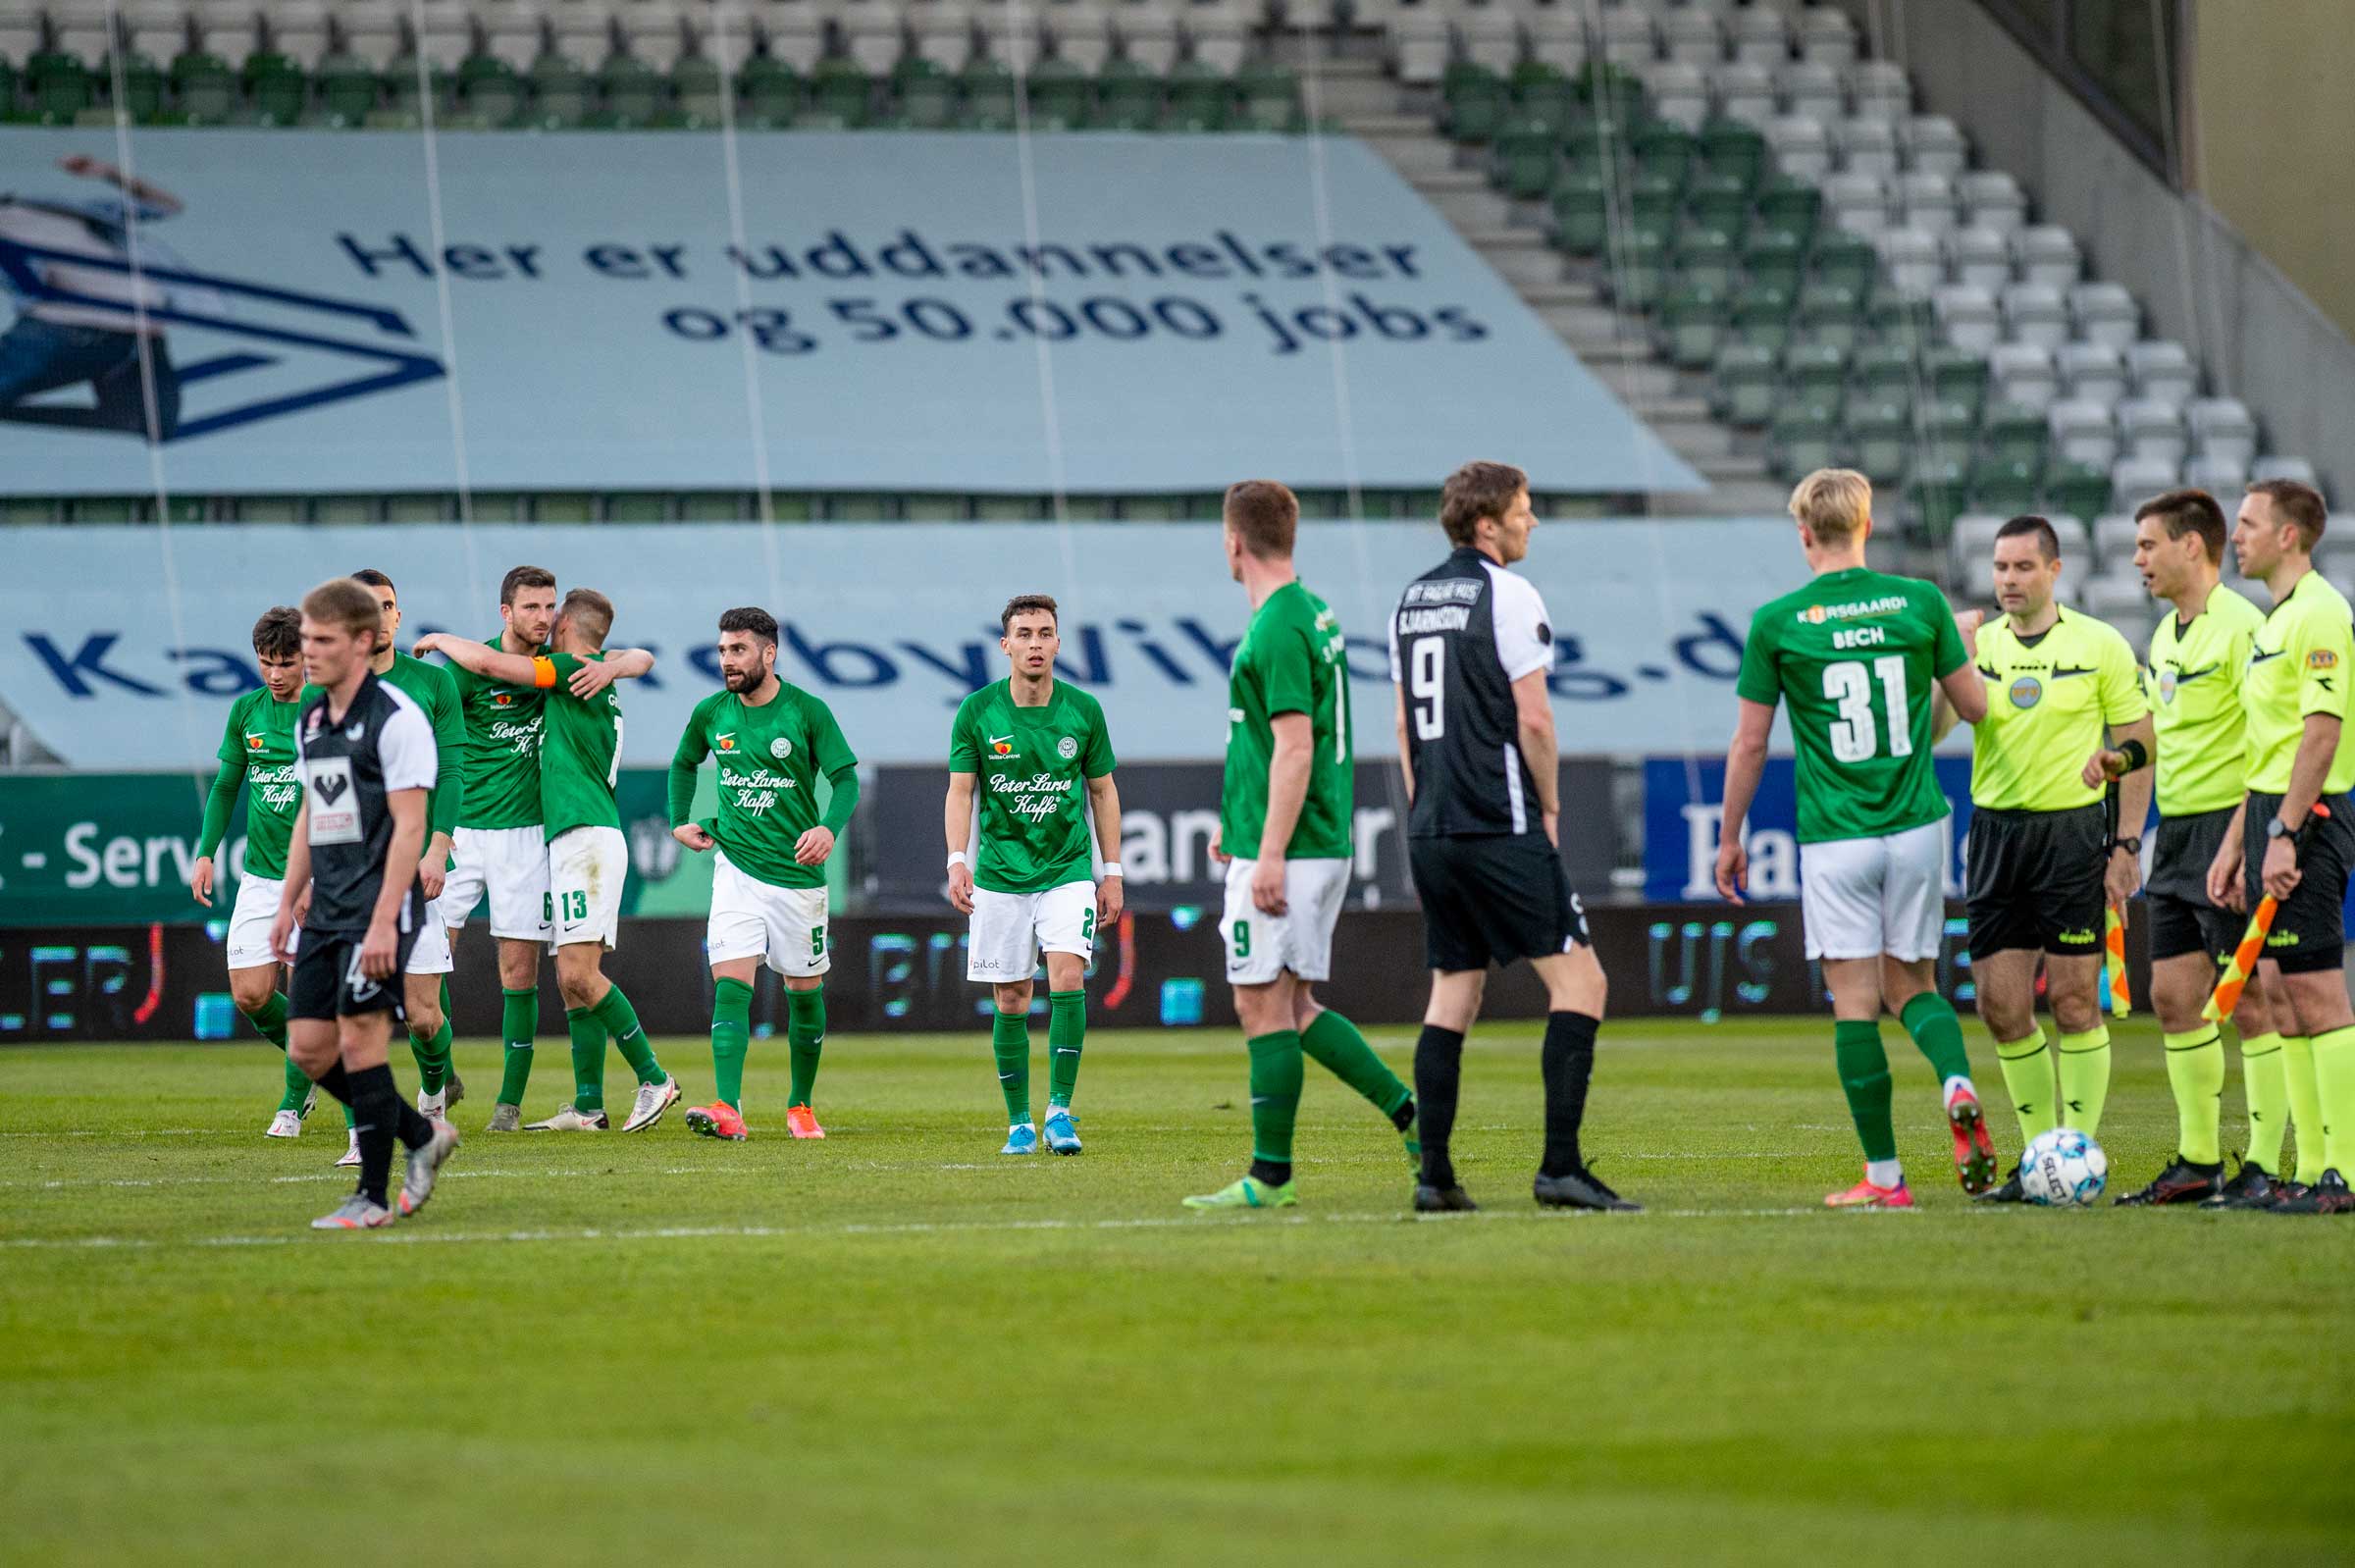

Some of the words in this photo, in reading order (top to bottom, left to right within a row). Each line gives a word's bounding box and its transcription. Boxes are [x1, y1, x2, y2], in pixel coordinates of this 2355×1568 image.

[335, 232, 542, 280] Her
[585, 240, 687, 280] er
[728, 229, 1420, 280] uddannelser
[662, 306, 818, 356] og
[826, 295, 1225, 342] 50.000
[1242, 292, 1490, 355] jobs
[1832, 626, 1886, 650] BECH
[1411, 635, 1445, 741] 9
[1822, 654, 1913, 763] 31
[719, 767, 751, 787] Peter
[747, 768, 798, 788] Larsen
[989, 773, 1031, 793] Peter
[261, 784, 296, 812] Kaffe
[733, 788, 775, 817] Kaffe
[1009, 794, 1058, 823] Kaffe
[560, 889, 588, 921] 13
[1081, 907, 1094, 940] 2
[1233, 919, 1250, 958] 9
[811, 925, 824, 956] 5
